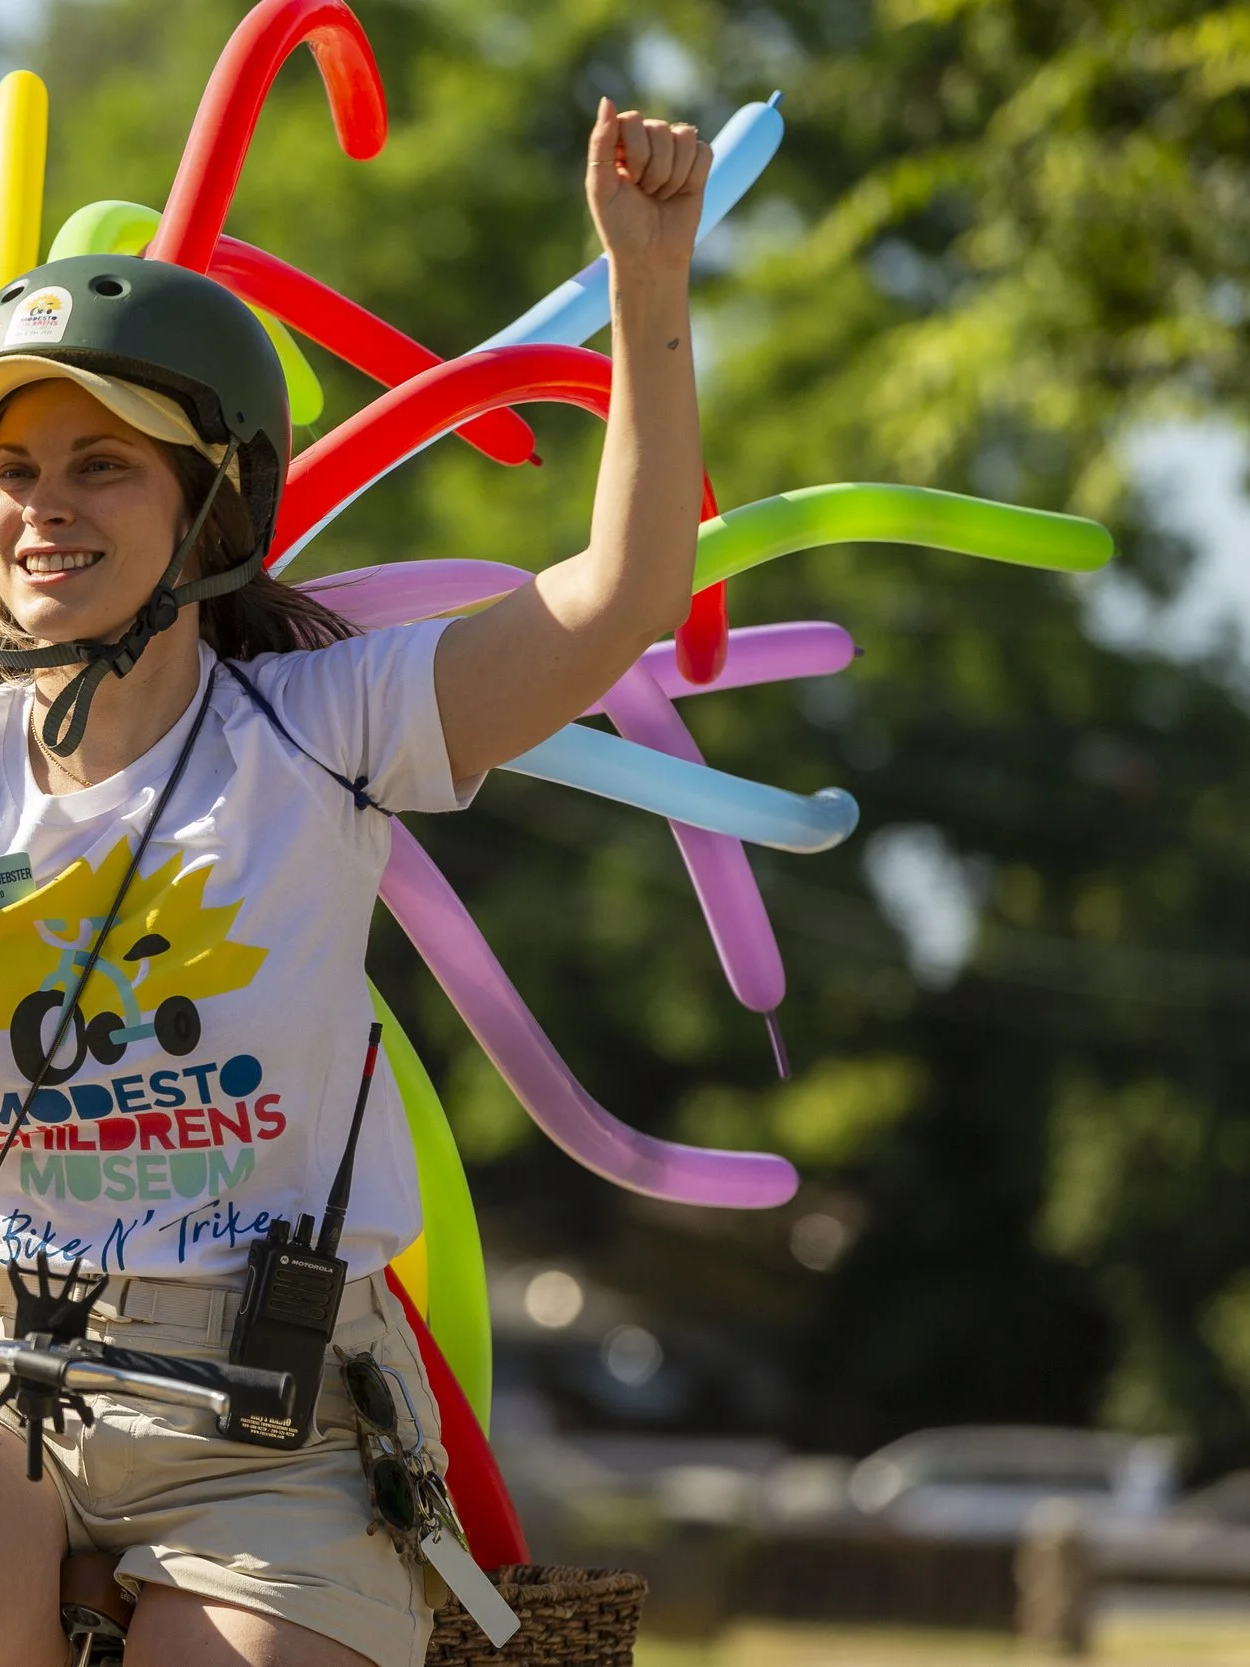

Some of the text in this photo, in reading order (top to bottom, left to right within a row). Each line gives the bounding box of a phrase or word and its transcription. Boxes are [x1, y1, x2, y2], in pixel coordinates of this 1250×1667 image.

[19, 1148, 256, 1202] MUSEUM
[0, 1208, 93, 1265] Bike
[291, 1260, 333, 1273] MOTOROLA
